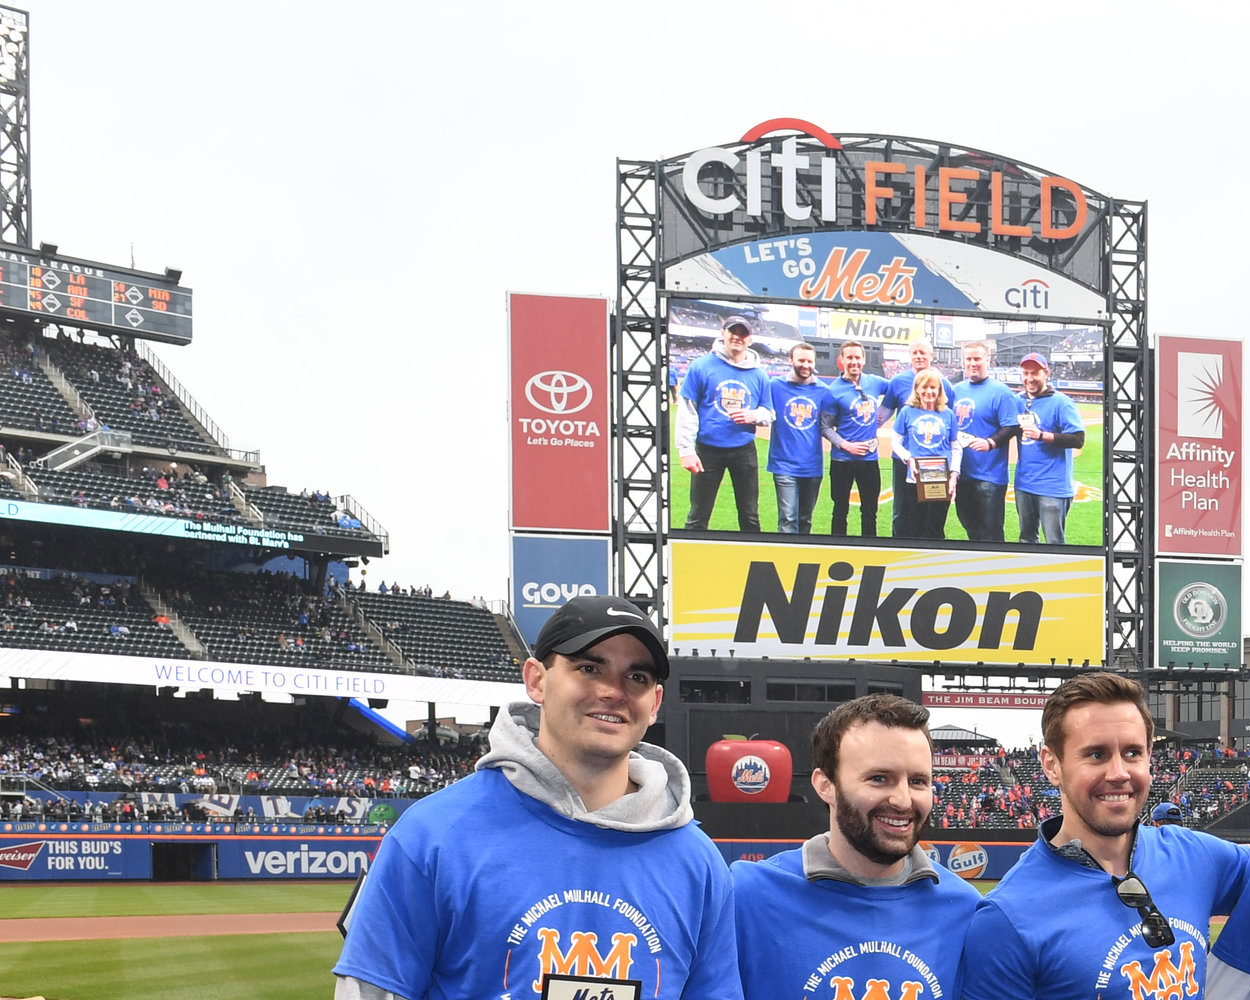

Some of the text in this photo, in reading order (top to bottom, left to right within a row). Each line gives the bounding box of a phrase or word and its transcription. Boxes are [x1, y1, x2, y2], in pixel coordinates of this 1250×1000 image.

[682, 133, 1088, 240] citi FIELD
[743, 237, 813, 263] LET'S
[40, 259, 104, 277] LEAGUE
[782, 258, 816, 279] GO
[799, 245, 918, 306] Mets
[69, 273, 85, 285] LA
[1004, 283, 1048, 309] citi
[844, 318, 910, 341] Nikon
[519, 418, 600, 436] TOYOTA
[527, 437, 595, 448] Let's Go Places
[1166, 443, 1235, 467] Affinity
[1171, 468, 1230, 489] Health
[1181, 491, 1219, 511] Plan
[184, 520, 304, 542] The Mulhall Foundation has
[228, 534, 247, 544] with
[1173, 528, 1235, 538] Affinity Health Plan
[733, 561, 1043, 650] Nikon
[1212, 641, 1237, 649] WORLD
[155, 664, 385, 694] WELCOME TO CITI FIELD
[738, 769, 764, 783] Mets
[47, 841, 122, 854] THIS BUD'S
[48, 856, 109, 870] FOR YOU.
[244, 844, 368, 874] verizon
[951, 853, 984, 870] Gulf
[507, 889, 662, 954] THE MICHAEL MULHALL FOUNDATION
[1095, 970, 1111, 989] THE
[1103, 934, 1132, 967] MICHAEL
[1168, 917, 1207, 949] FOUNDATION
[803, 941, 943, 999] THE MICHAEL MULHALL FOUNDATION
